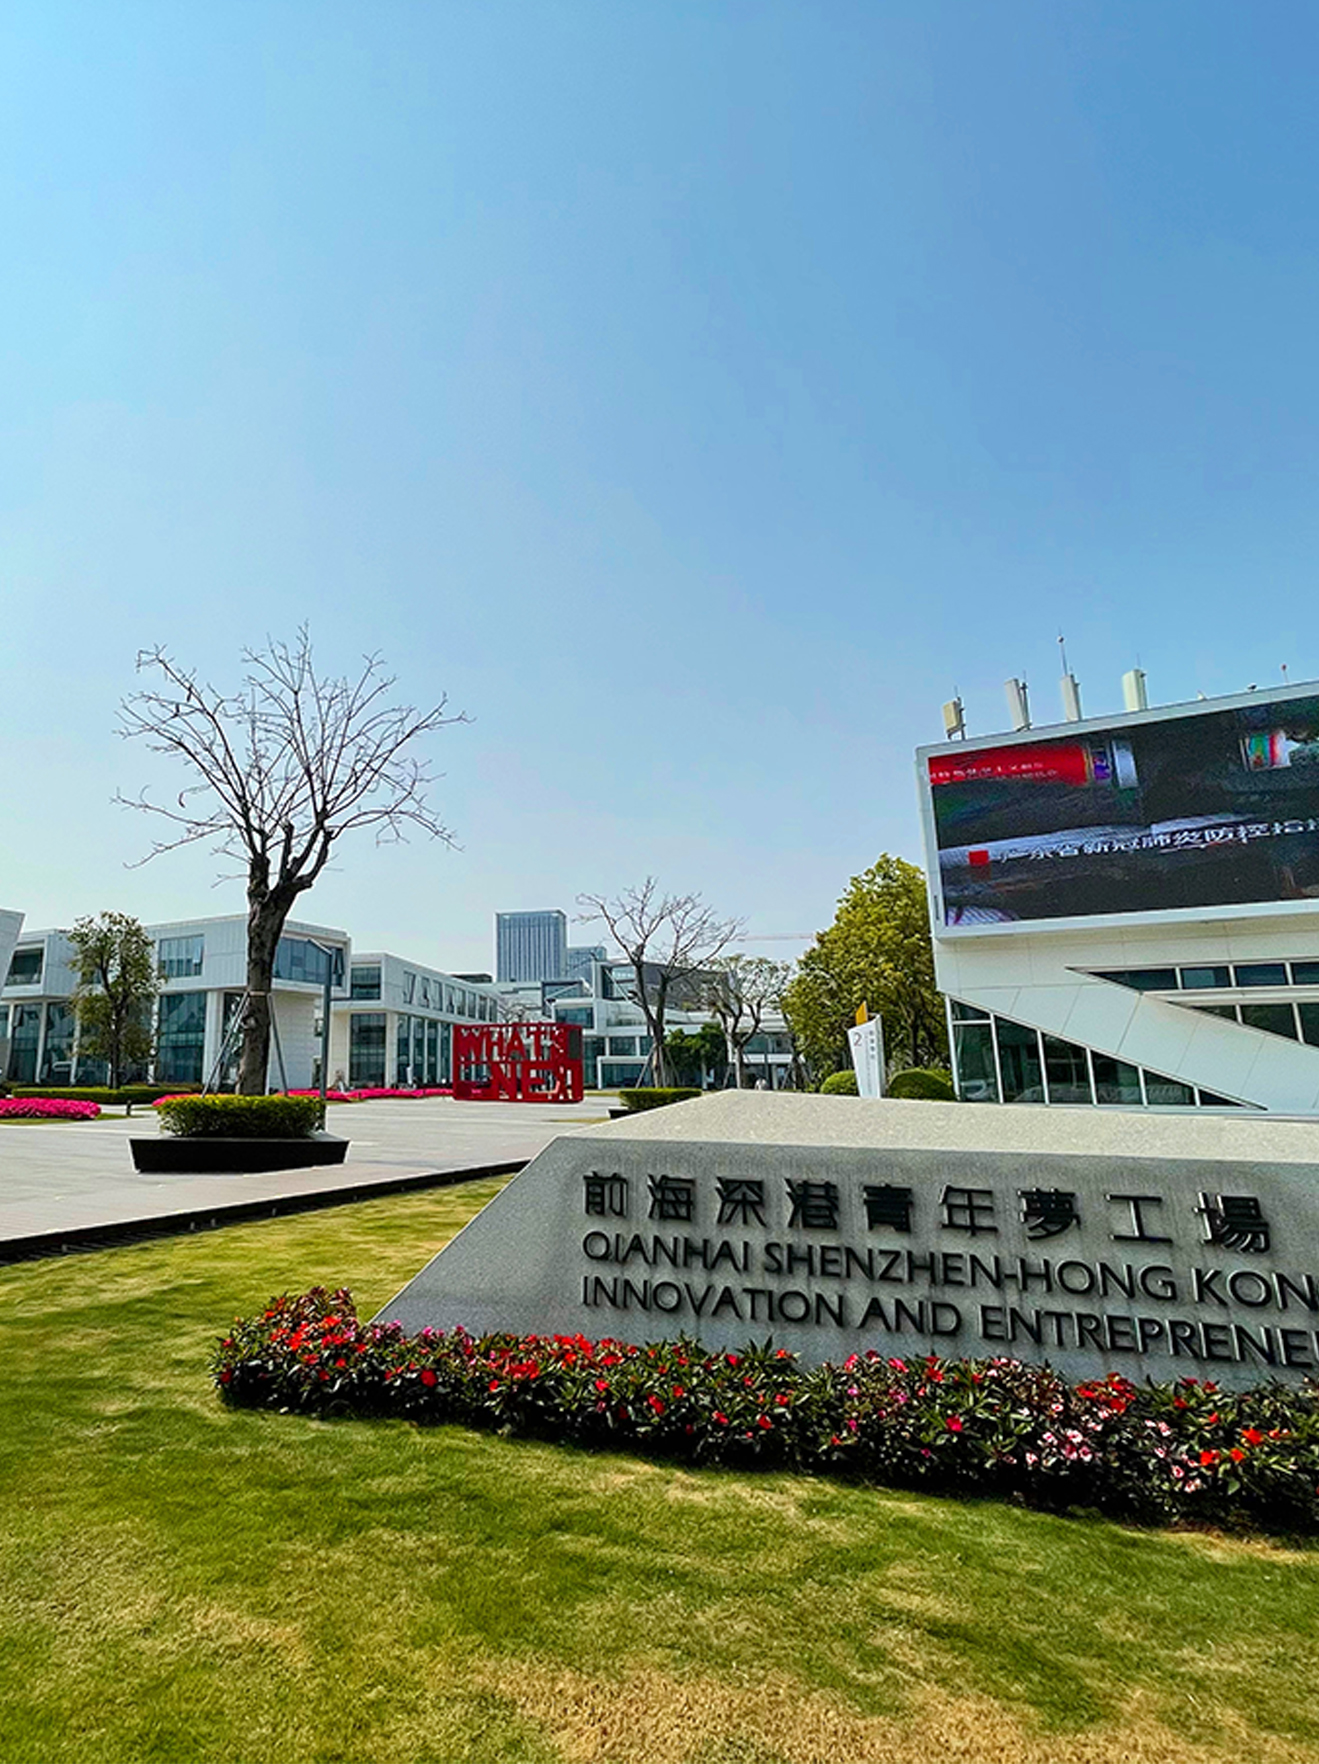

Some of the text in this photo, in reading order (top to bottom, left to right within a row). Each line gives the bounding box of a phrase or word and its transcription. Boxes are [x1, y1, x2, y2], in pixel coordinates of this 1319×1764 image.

[853, 1032, 863, 1047] 2
[583, 1170, 1271, 1253] 前海深港青年夢工場
[583, 1230, 750, 1273] QIANHAI
[763, 1241, 1178, 1302] SHENZHEN-HONG
[582, 1275, 1319, 1369] INNOVATION AND ENTREPRENE
